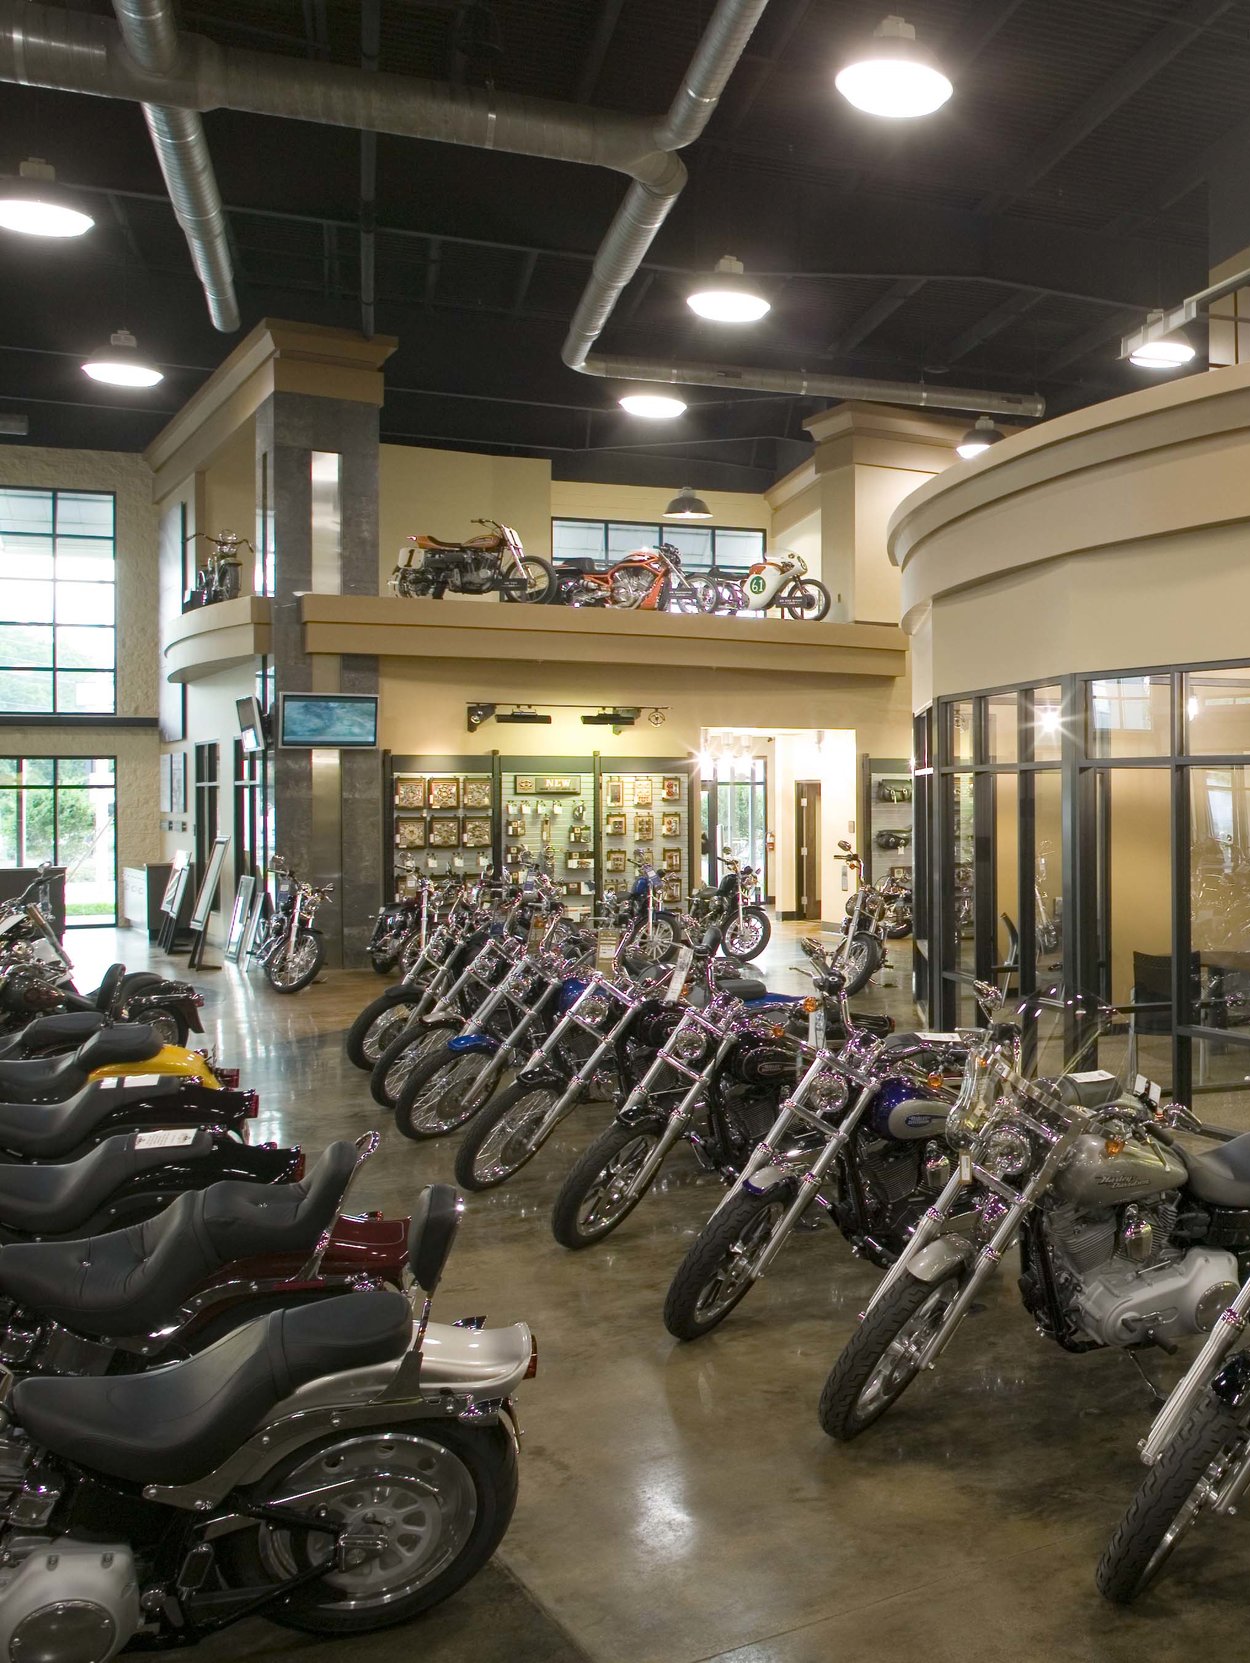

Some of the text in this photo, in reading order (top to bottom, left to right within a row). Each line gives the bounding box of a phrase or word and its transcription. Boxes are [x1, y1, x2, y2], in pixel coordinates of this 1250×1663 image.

[404, 549, 415, 567] 1
[751, 579, 764, 592] 61
[545, 778, 571, 787] NEW
